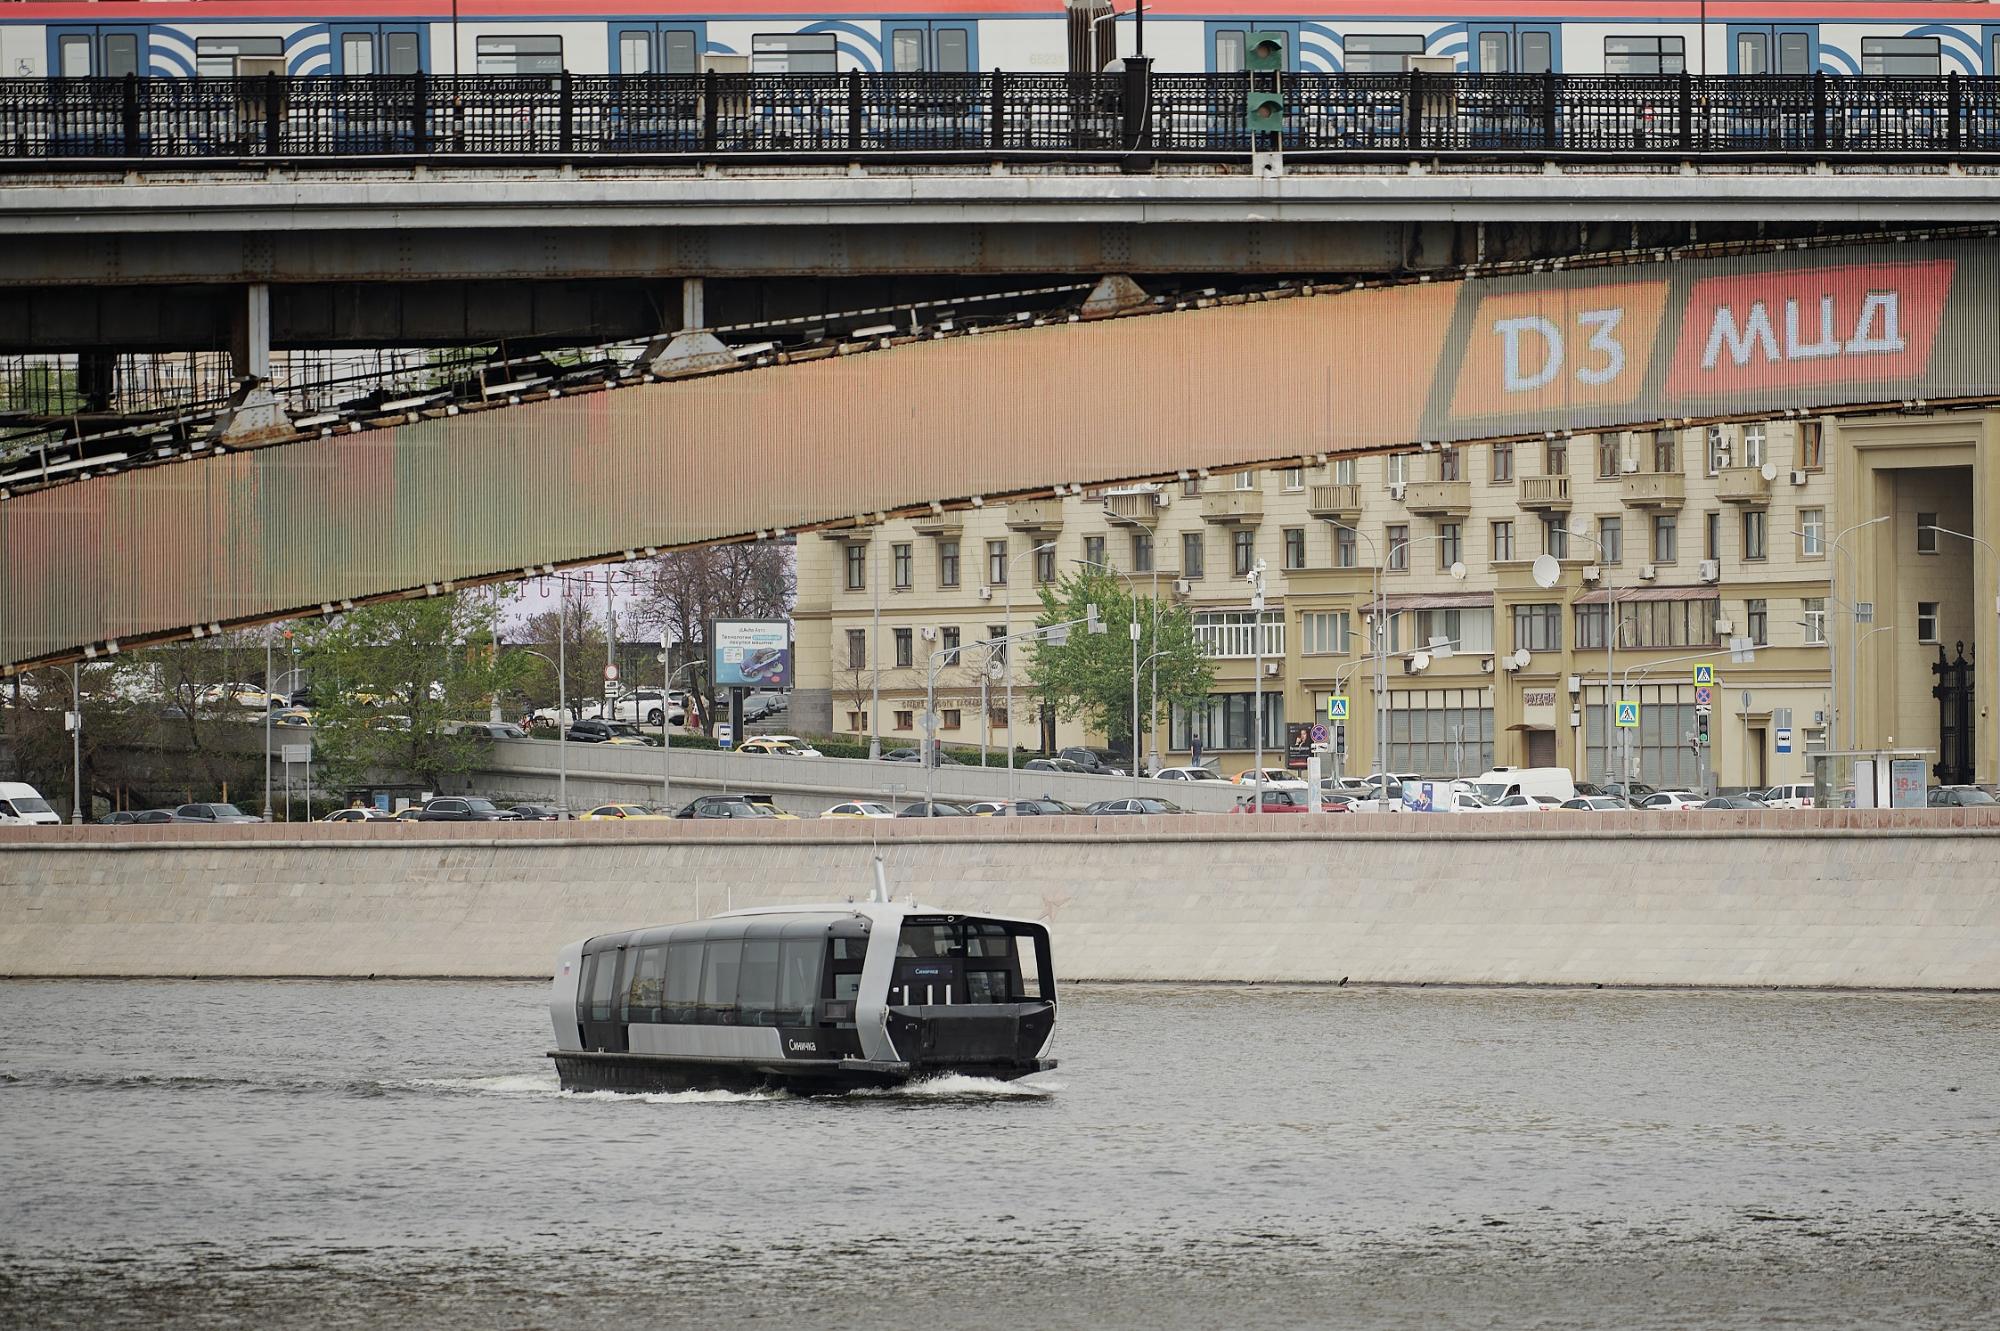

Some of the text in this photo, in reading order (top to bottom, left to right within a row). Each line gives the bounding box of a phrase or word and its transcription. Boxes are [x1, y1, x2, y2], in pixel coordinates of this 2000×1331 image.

[1493, 308, 1626, 393] D3
[1701, 289, 1906, 370] МЦД
[788, 1038, 817, 1052] Синичка
